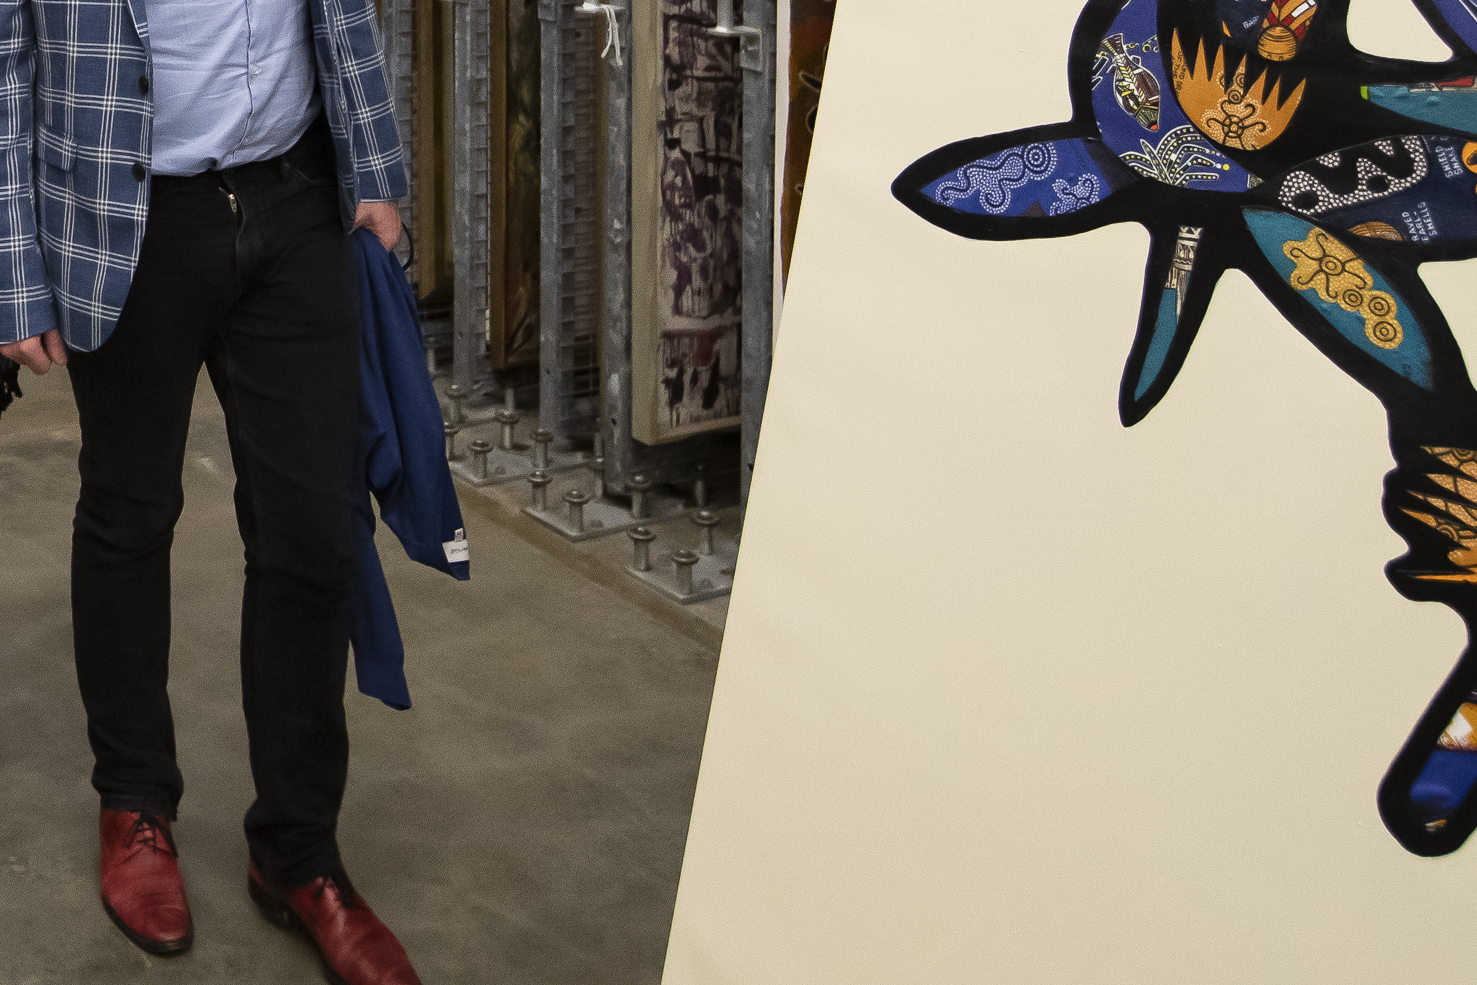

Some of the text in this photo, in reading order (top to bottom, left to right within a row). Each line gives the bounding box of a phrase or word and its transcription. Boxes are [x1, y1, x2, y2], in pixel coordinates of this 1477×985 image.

[1435, 145, 1454, 178] SHIELD
[1445, 146, 1464, 176] SNAKE
[1401, 211, 1420, 241] RAVED
[1417, 201, 1438, 237] SHELLS
